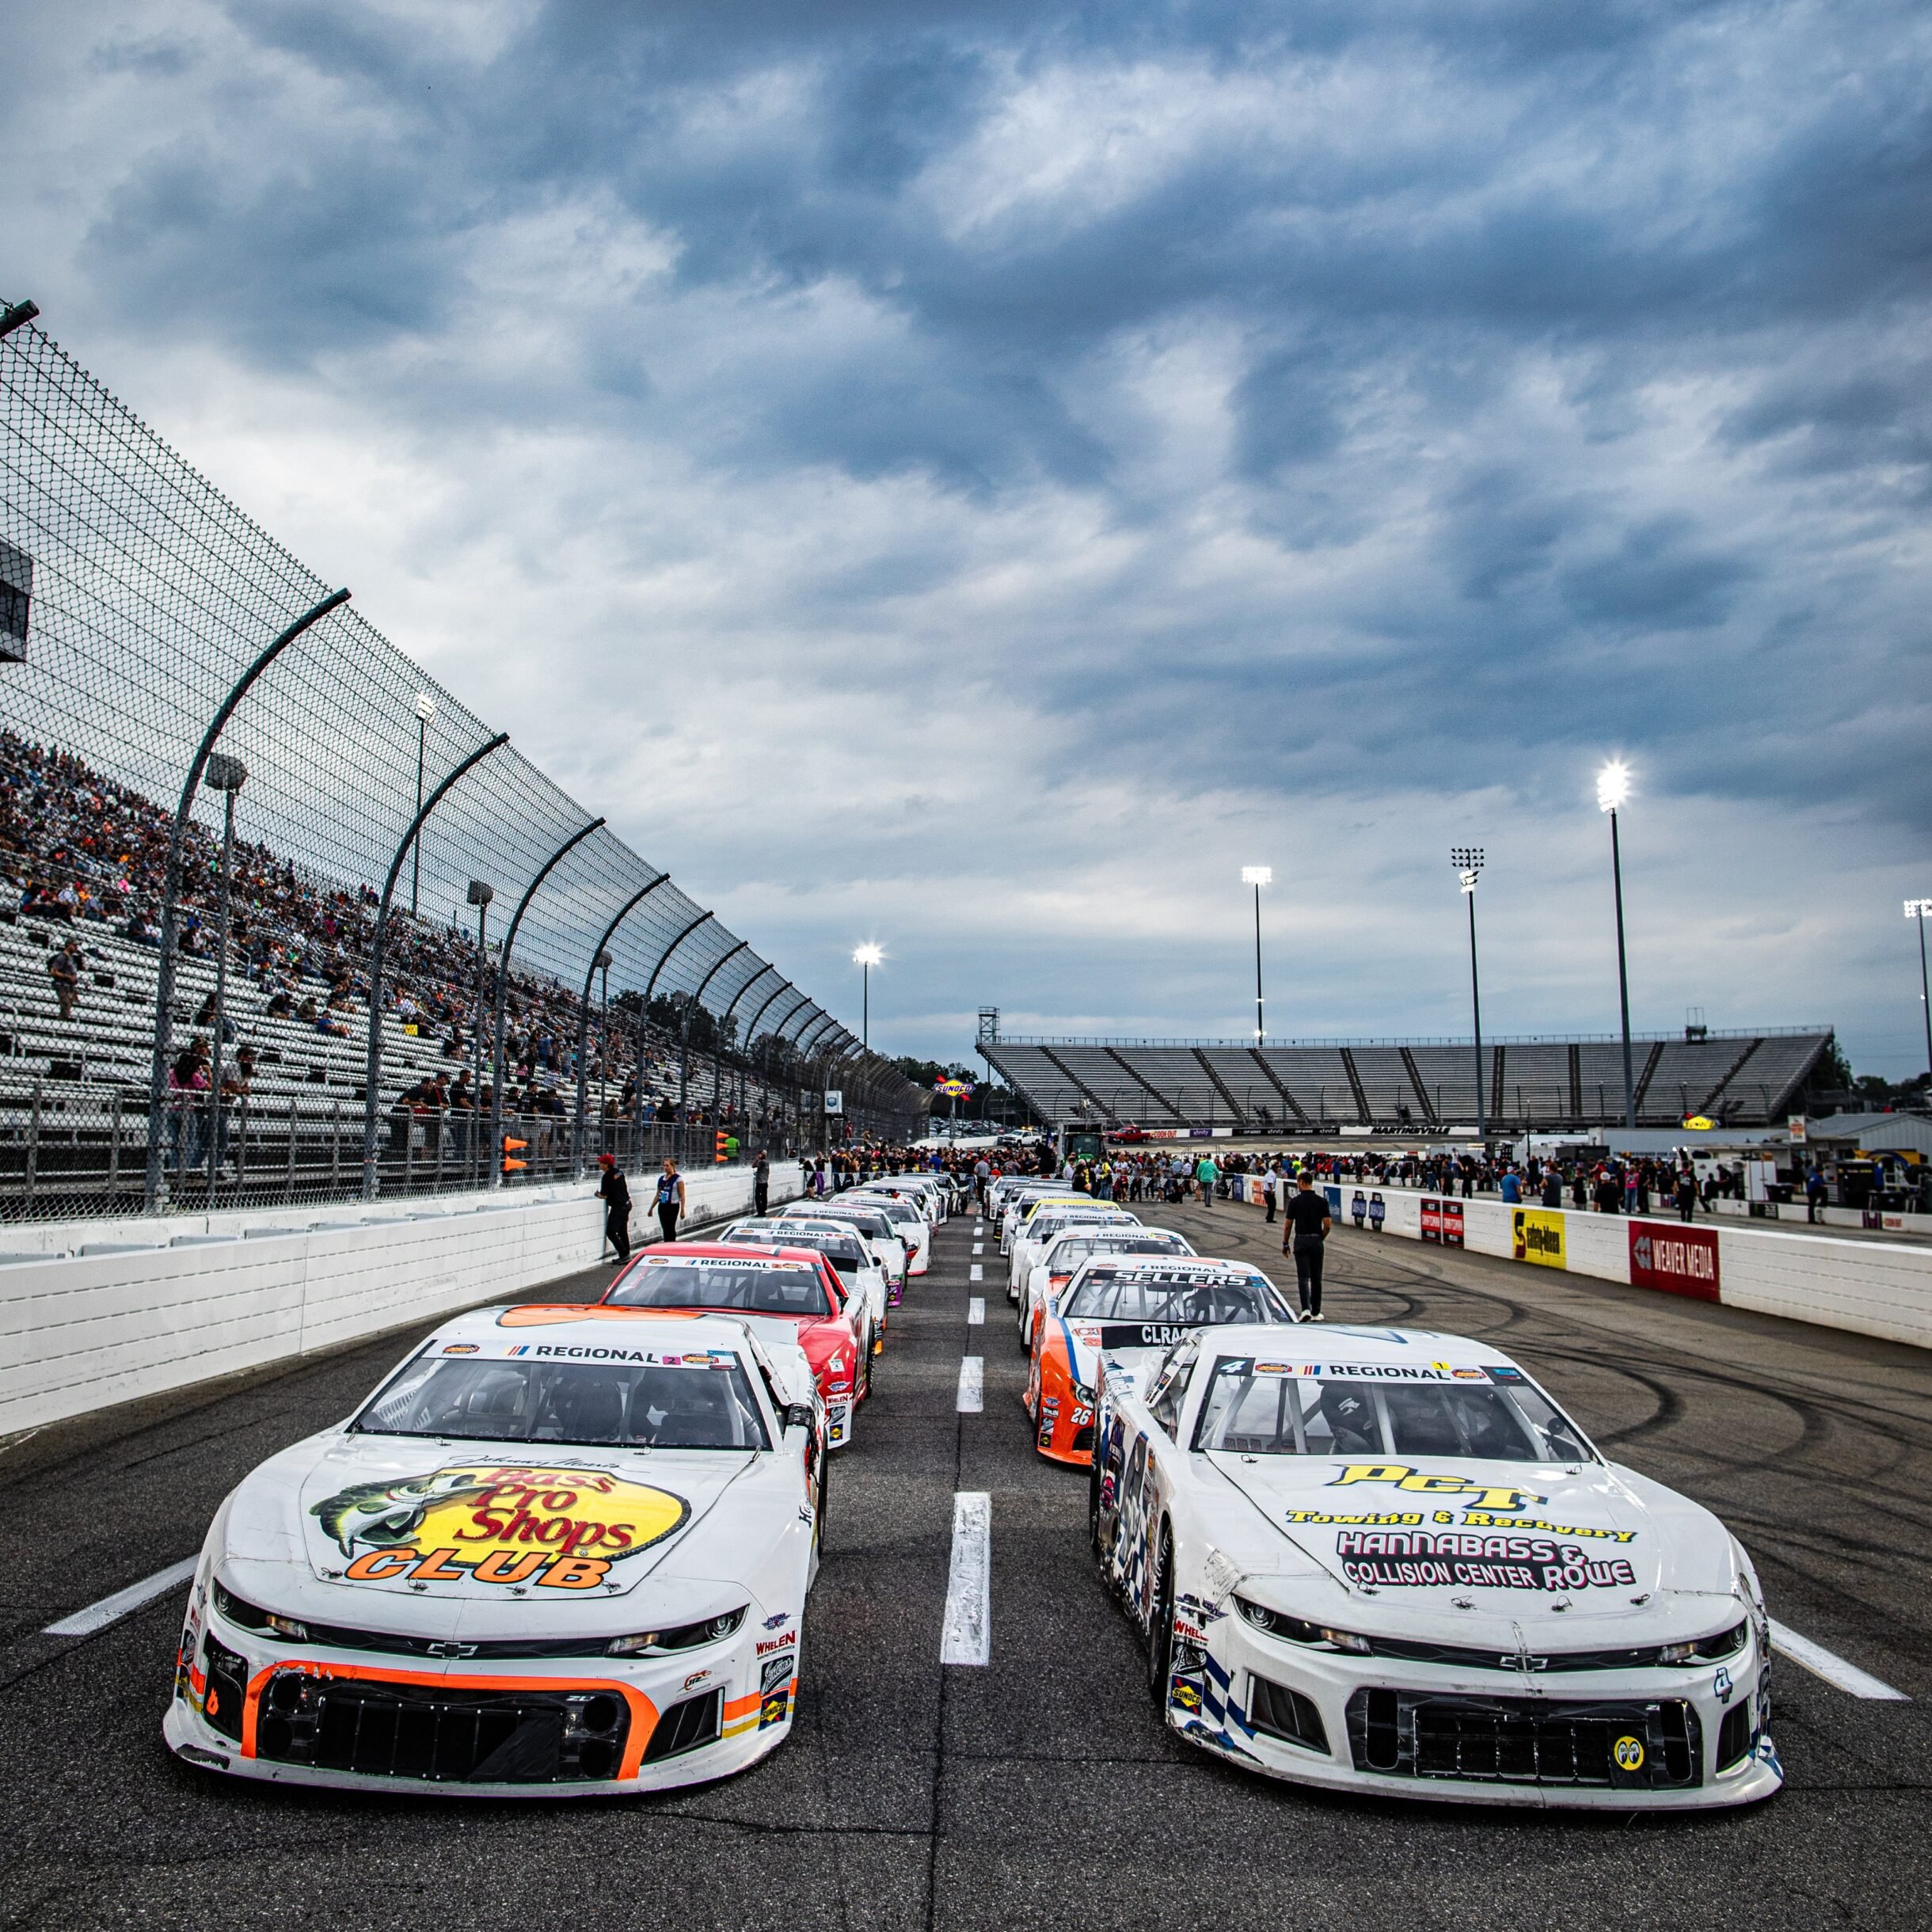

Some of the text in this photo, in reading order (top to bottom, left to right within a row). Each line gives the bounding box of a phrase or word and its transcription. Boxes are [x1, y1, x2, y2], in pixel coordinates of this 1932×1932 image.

[701, 1259, 770, 1268] REGIONAL
[1150, 1265, 1220, 1273] REGIONAL
[1652, 1239, 1714, 1280] WEAVER MEDIA
[1113, 1270, 1247, 1286] SELLERS
[536, 1345, 660, 1363] REGIONAL
[667, 1356, 675, 1365] 2
[1220, 1360, 1246, 1374] 4
[1329, 1365, 1451, 1380] REGIONAL
[1071, 1406, 1093, 1426] 26
[476, 1467, 616, 1493] Bass
[1324, 1463, 1548, 1512] PCT
[466, 1483, 578, 1510] Pro
[453, 1507, 636, 1555] Shops
[1286, 1509, 1638, 1543] Towing & Recovery
[1337, 1531, 1589, 1567] HANNABASS &
[344, 1547, 613, 1590] CLUB
[1344, 1559, 1637, 1592] COLLISION CENTER ROWE
[756, 1630, 796, 1656] WHELEN
[1173, 1619, 1209, 1641] WHEL
[1173, 1688, 1201, 1706] SUNOCO
[1714, 1667, 1733, 1704] 4
[762, 1702, 786, 1721] SUNOCO
